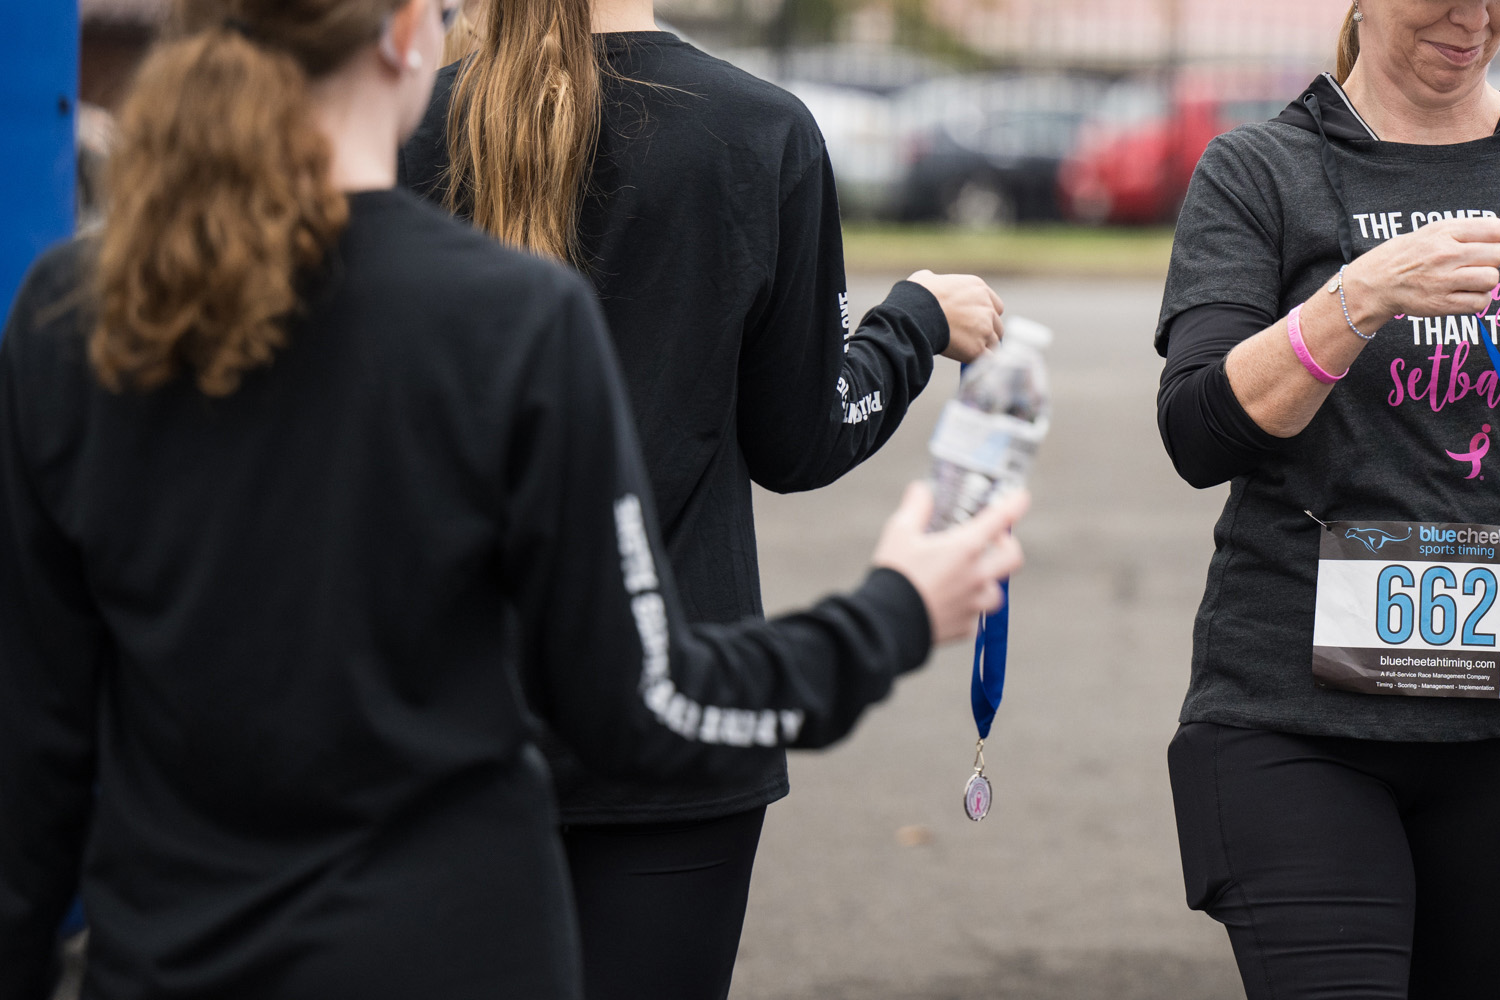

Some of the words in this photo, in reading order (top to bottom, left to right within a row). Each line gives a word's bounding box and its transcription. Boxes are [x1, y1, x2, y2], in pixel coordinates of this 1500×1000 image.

[1352, 211, 1403, 240] THE
[1407, 314, 1480, 346] THAN
[1419, 543, 1455, 557] sports
[1458, 544, 1495, 559] timing
[1375, 564, 1499, 647] 662
[1380, 655, 1496, 670] bluecheetahtiming.com
[1432, 672, 1466, 680] Management
[1376, 681, 1394, 689] Timing
[1397, 682, 1417, 690] Scoring
